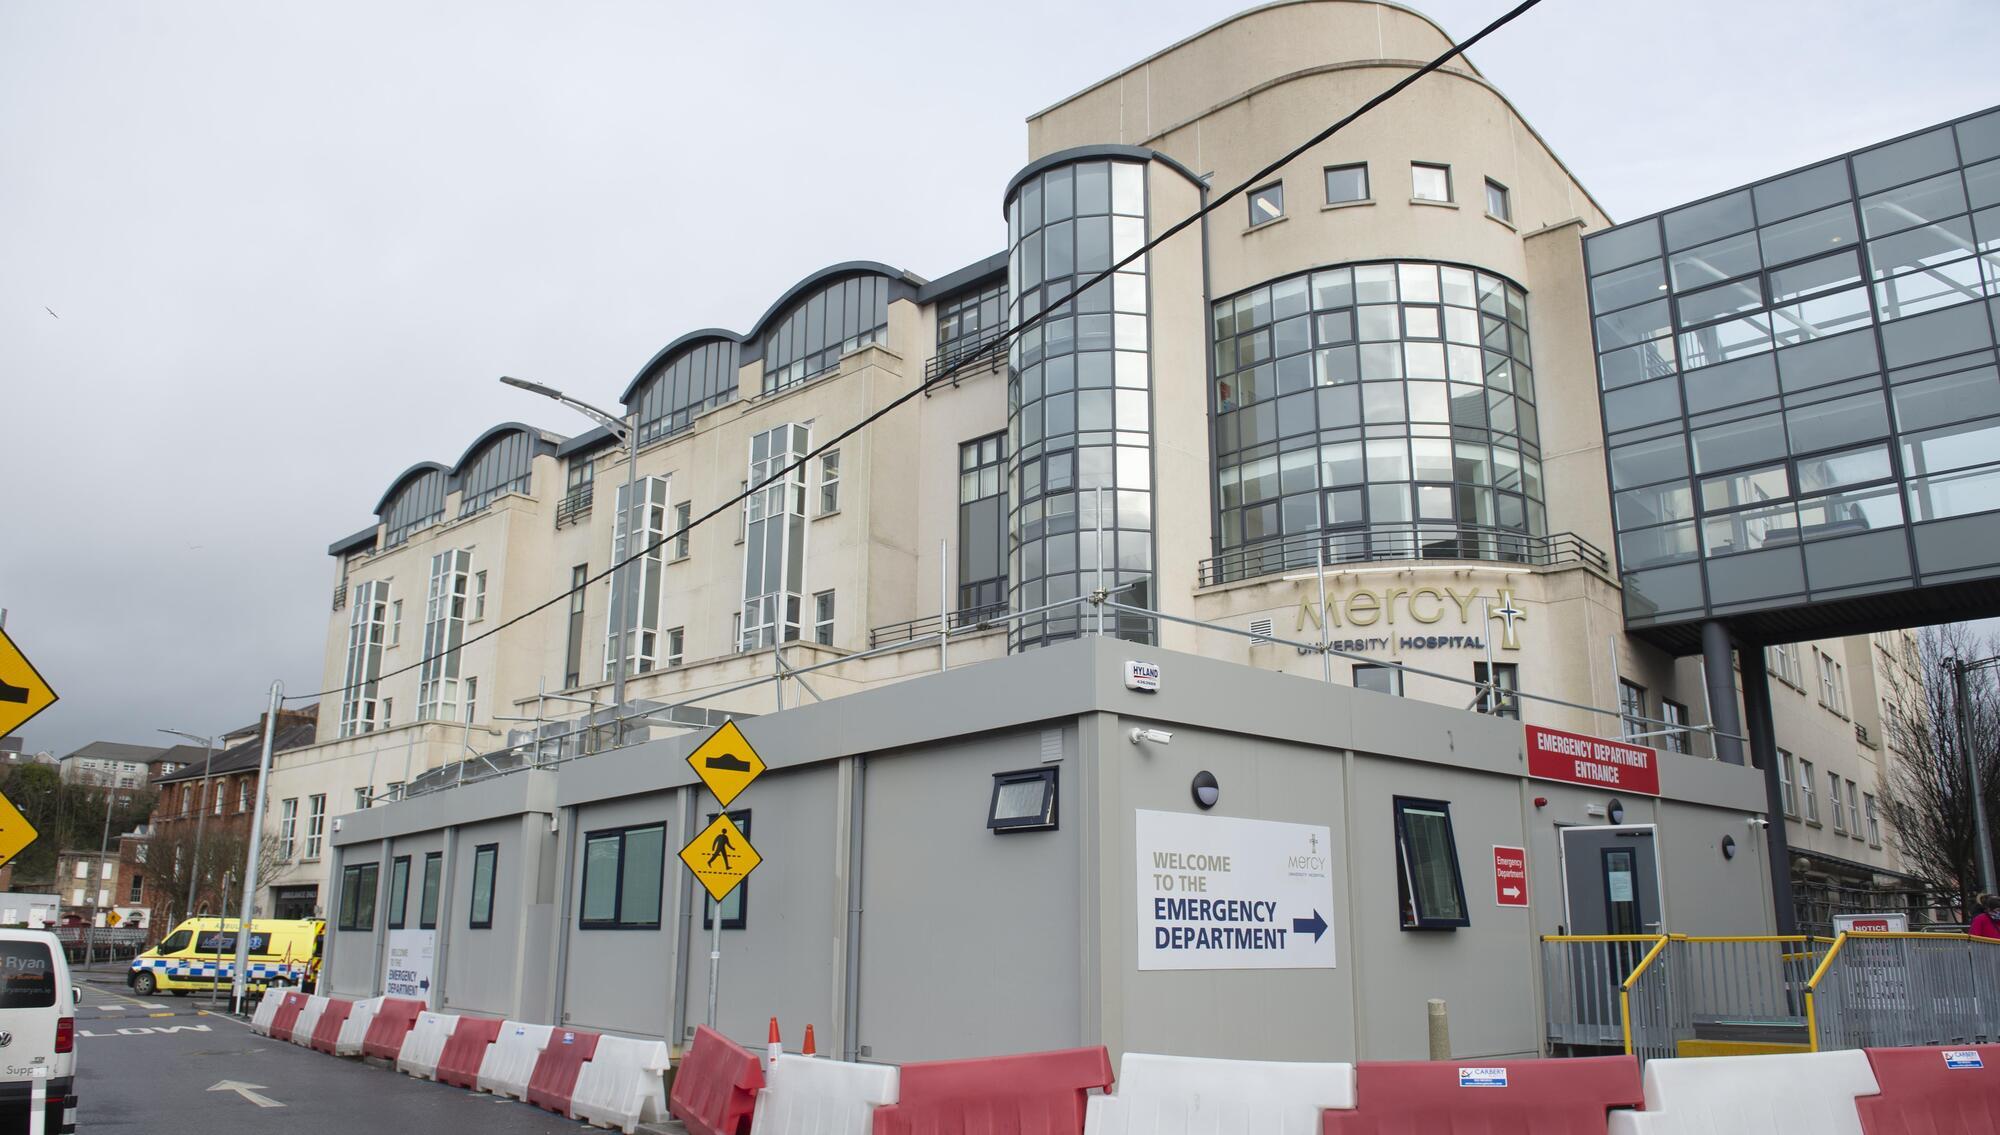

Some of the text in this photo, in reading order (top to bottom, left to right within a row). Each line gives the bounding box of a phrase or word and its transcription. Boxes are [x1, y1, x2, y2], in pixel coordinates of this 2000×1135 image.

[1400, 635, 1485, 650] HOSPITAL
[1133, 666, 1159, 678] HYLAND
[1537, 732, 1648, 769] EMERGENCY DEPARTMENT
[1575, 760, 1619, 784] ENTRANCE
[1153, 852, 1231, 872] WELCOME
[1497, 856, 1522, 868] Emergency
[1497, 868, 1524, 879] Department
[1153, 874, 1207, 892] TO THE
[1154, 898, 1277, 922] EMERGENCY
[1155, 926, 1287, 950] DEPARTMENT
[6, 956, 45, 970] Ryan
[74, 1024, 213, 1037] LOW
